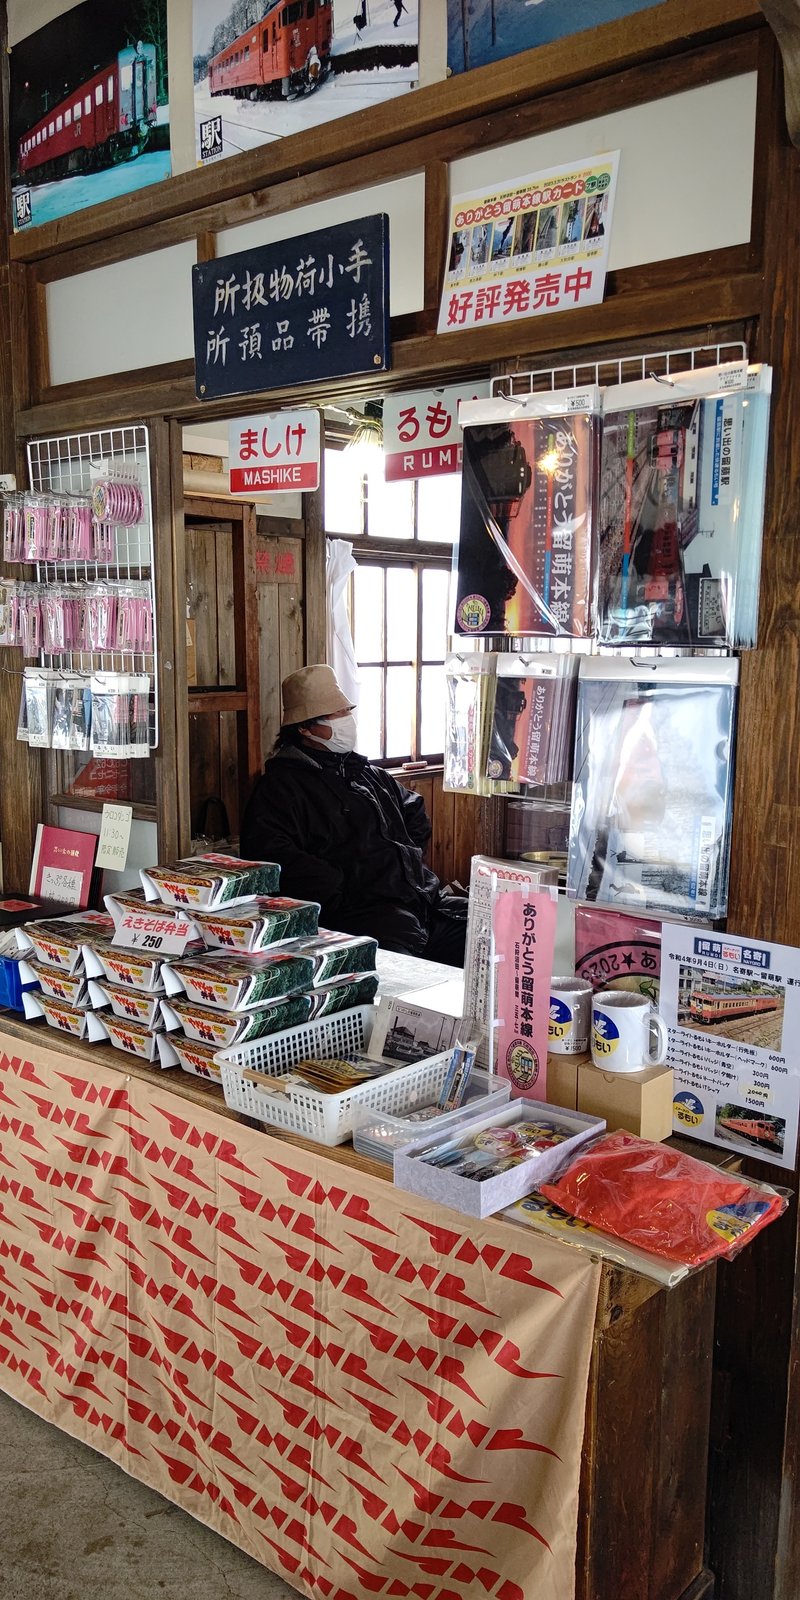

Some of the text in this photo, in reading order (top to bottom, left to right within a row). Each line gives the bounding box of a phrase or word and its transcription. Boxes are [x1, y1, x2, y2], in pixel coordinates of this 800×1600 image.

[73, 124, 82, 137] JR
[202, 117, 222, 148] 駅
[202, 146, 222, 158] STATION
[16, 191, 31, 218] 駅
[456, 180, 585, 227] ありがとう留萌本線駅カード
[447, 266, 593, 327] 好評発売中
[396, 394, 480, 443] るも
[238, 422, 307, 461] ましけ
[243, 466, 302, 486] MASHIKE
[550, 431, 574, 624] ありがとう留萌本線
[527, 685, 546, 777] ありがとう留萌本線
[122, 915, 190, 937] えきそば弁当
[141, 934, 163, 949] 250
[702, 941, 721, 952] 留萌
[723, 950, 741, 960] るもい
[743, 949, 762, 961] 名寄
[520, 902, 538, 1039] ありがとう留萌本線
[768, 1054, 786, 1065] 600円
[752, 1070, 769, 1080] 300円
[771, 1064, 788, 1075] 600円
[753, 1080, 770, 1090] 300円
[745, 1097, 765, 1108] 1500円
[677, 1111, 699, 1124] るもい
